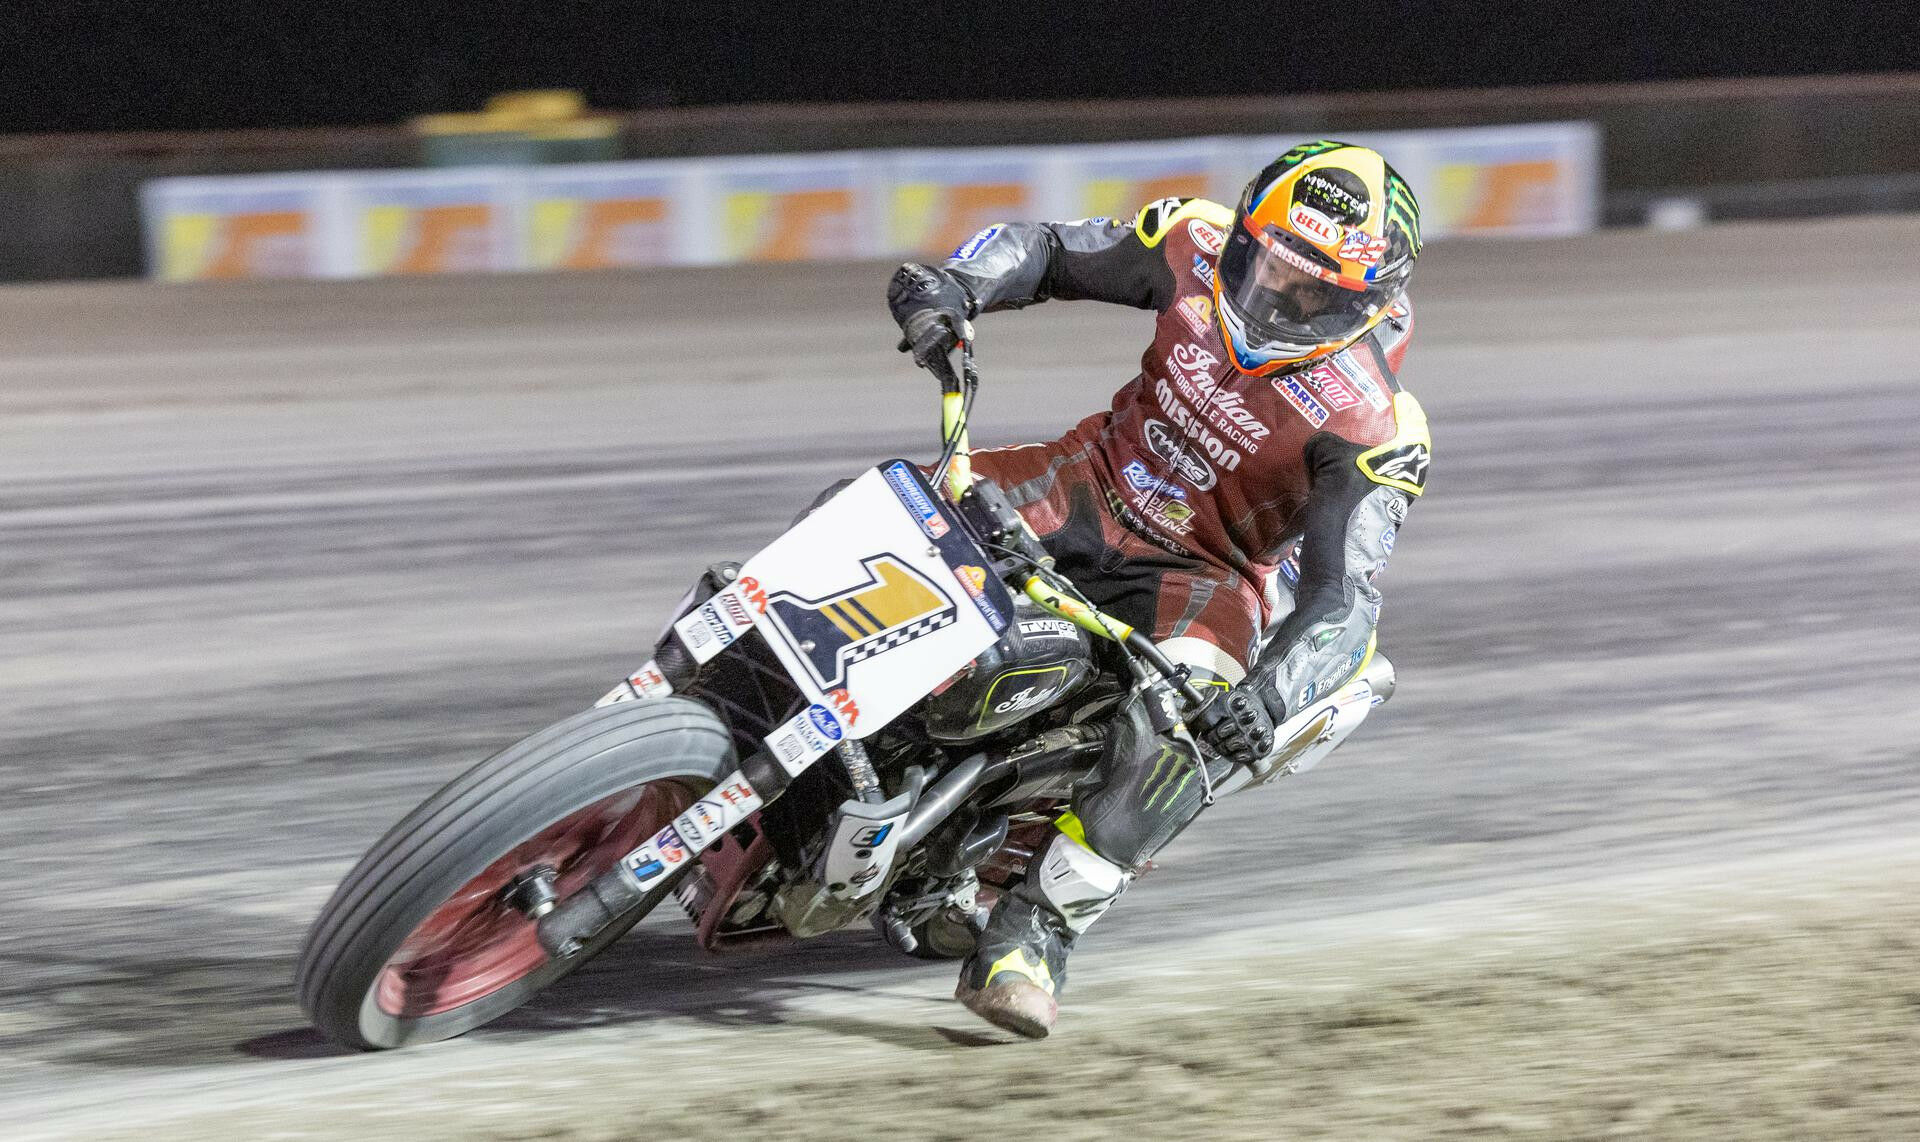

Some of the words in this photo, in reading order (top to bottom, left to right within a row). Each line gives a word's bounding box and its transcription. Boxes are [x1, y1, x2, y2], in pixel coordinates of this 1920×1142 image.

[1195, 226, 1223, 251] BELL
[1295, 212, 1330, 240] BELL
[1166, 355, 1217, 422] MOTORCYCLE
[1219, 420, 1259, 455] RACING
[1174, 343, 1270, 441] Indian
[1273, 379, 1321, 426] UNLIMITED
[1281, 376, 1328, 421] PARTS
[1312, 368, 1351, 406] KLOTZ
[1132, 497, 1195, 535] RACING
[739, 576, 769, 615] RK
[765, 551, 958, 693] 1
[828, 688, 860, 728] RK
